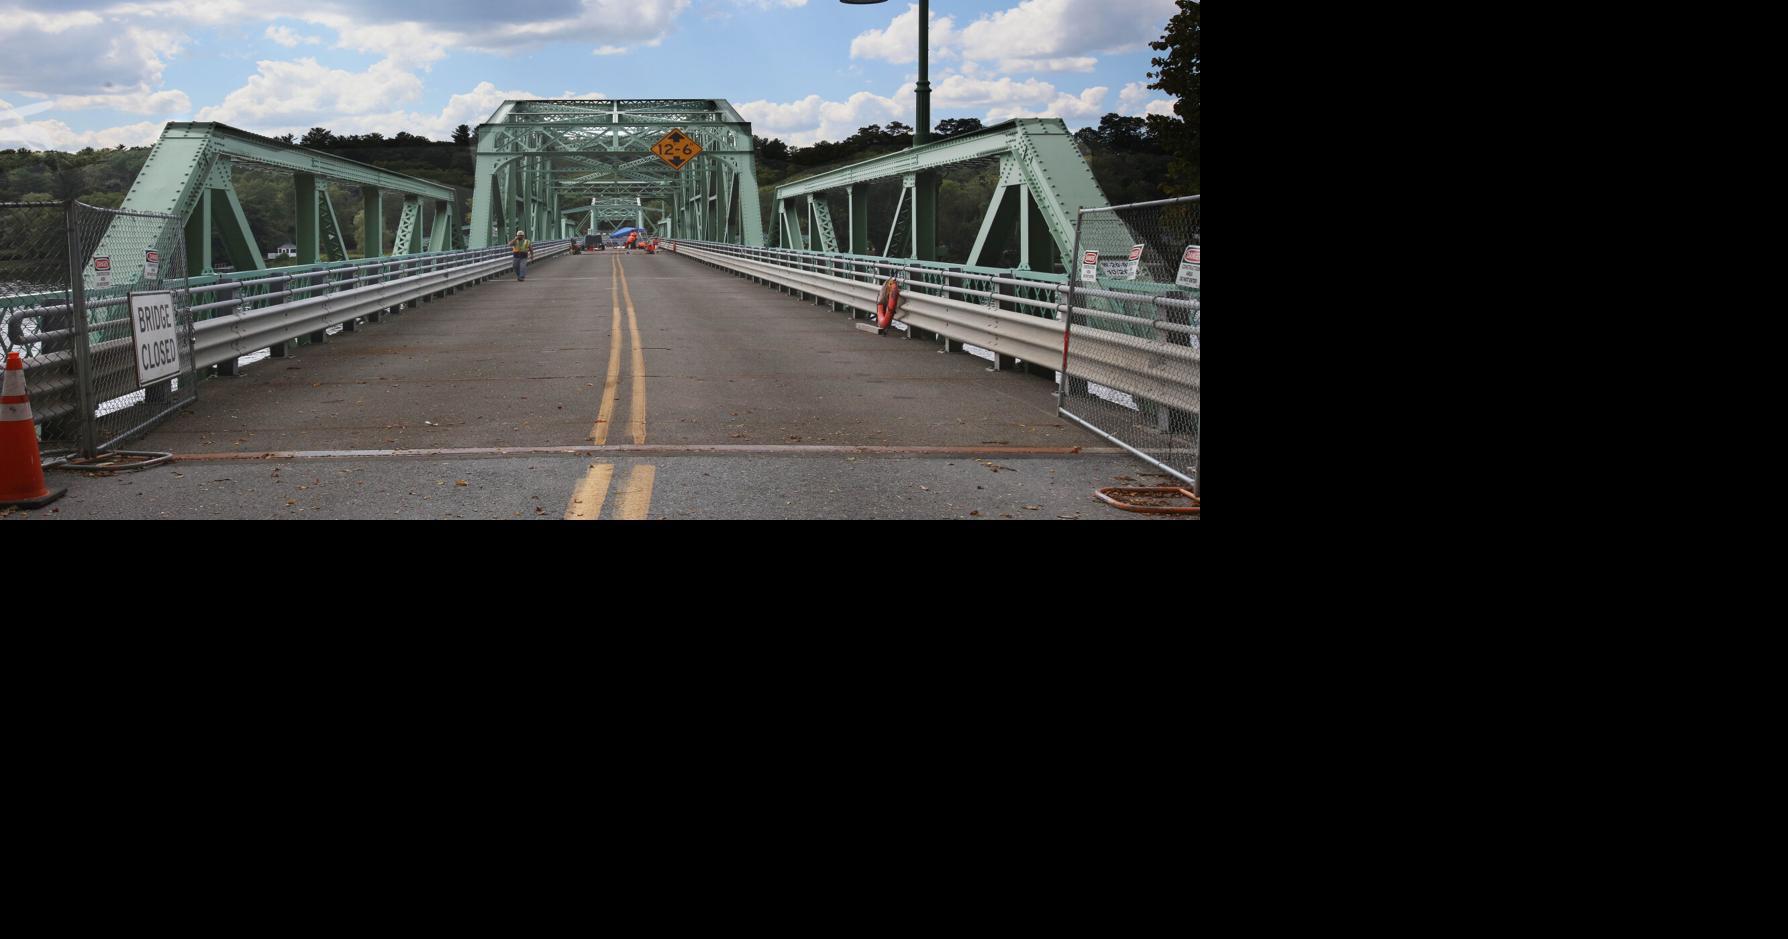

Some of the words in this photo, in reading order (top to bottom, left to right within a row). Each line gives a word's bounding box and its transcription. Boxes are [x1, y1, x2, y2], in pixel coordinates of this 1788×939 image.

[658, 144, 692, 155] 12-6
[138, 304, 171, 333] BRIDGE
[141, 338, 176, 370] CLOSED
